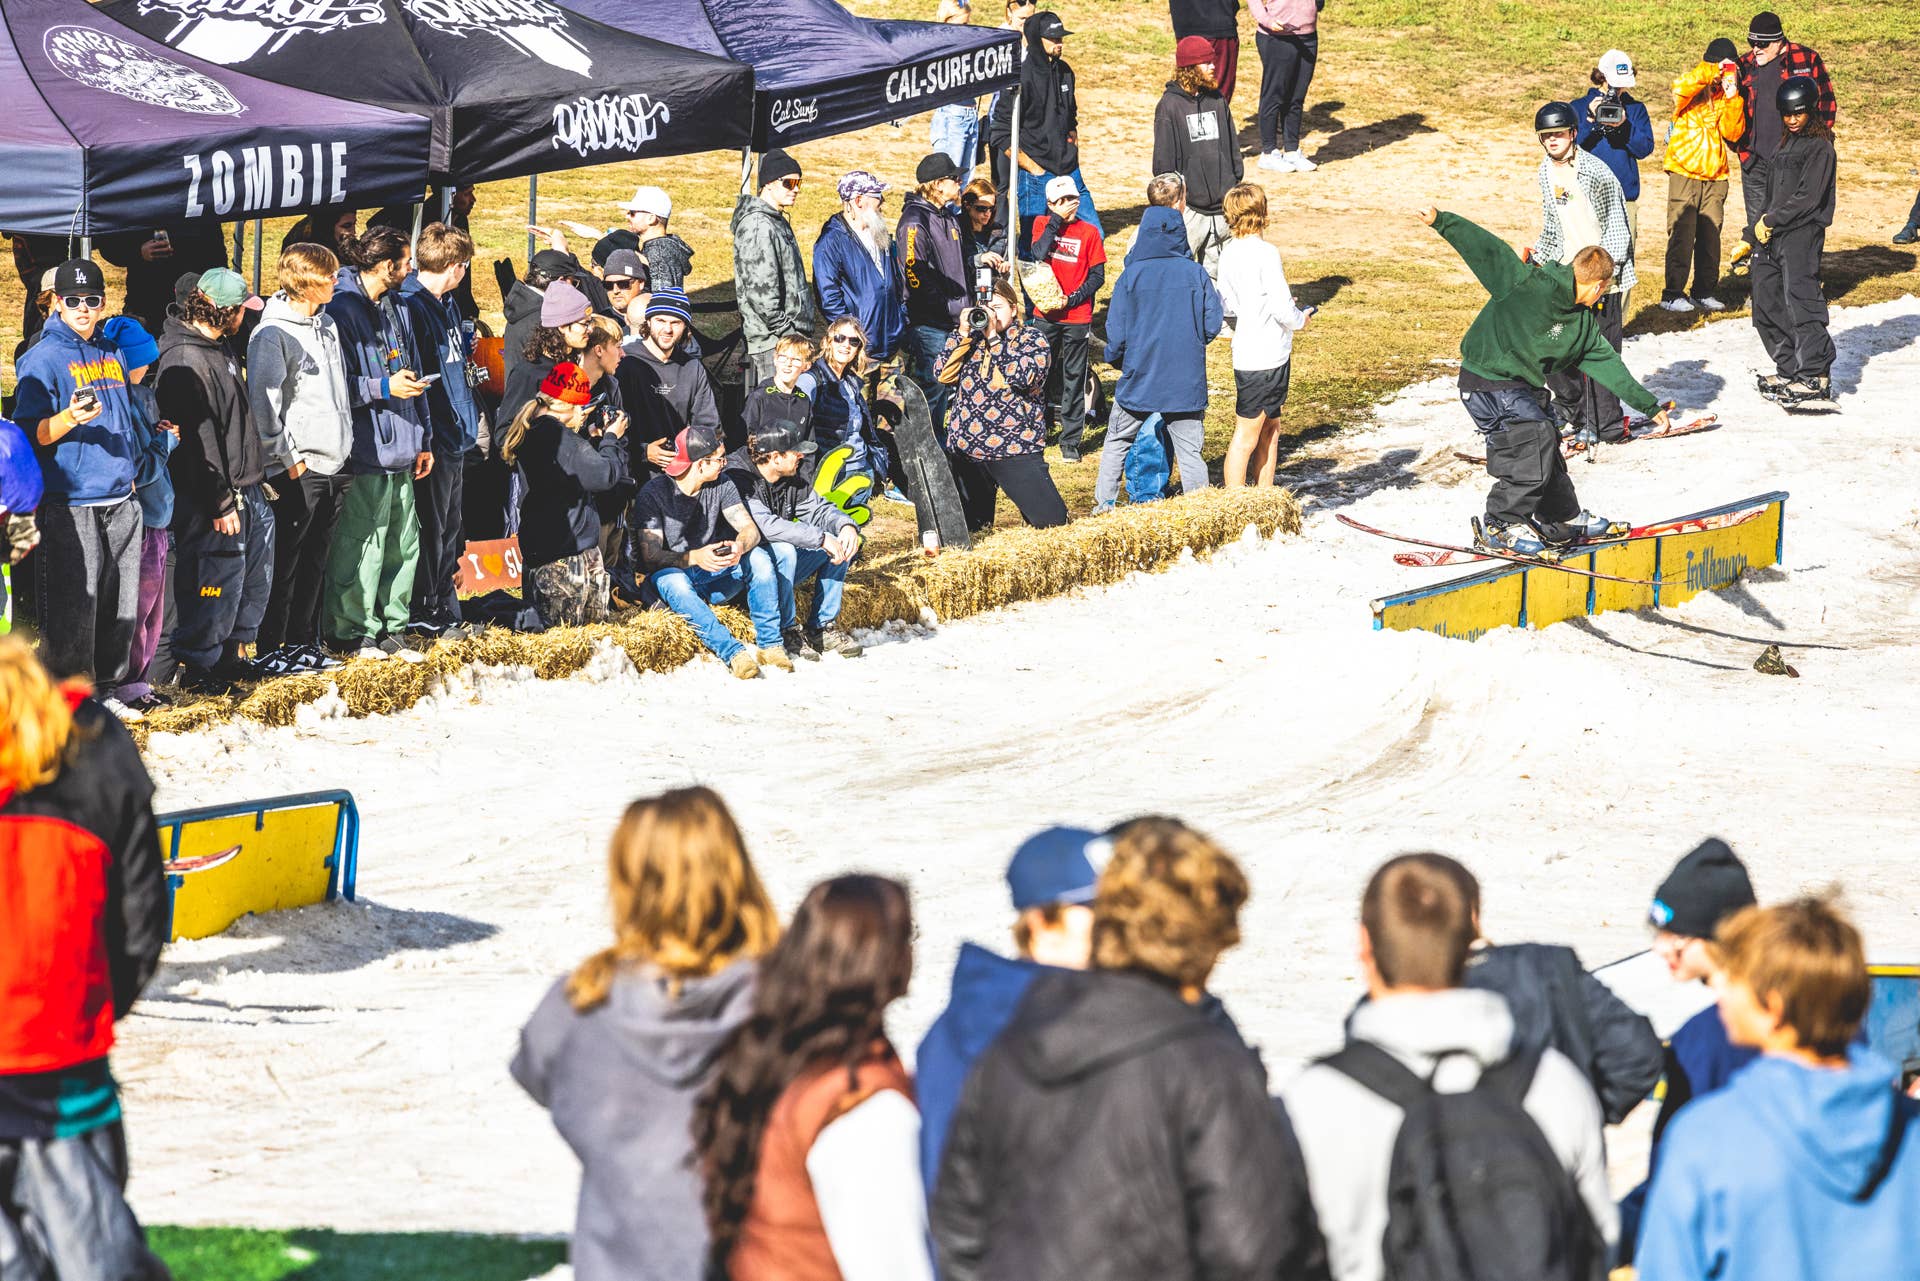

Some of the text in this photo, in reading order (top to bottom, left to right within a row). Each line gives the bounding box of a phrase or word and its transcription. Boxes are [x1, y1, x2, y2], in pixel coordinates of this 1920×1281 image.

[52, 30, 140, 67] ZOMBIE
[885, 43, 1013, 104] CAL-SURF.COM
[552, 93, 670, 157] DAMAGE
[770, 98, 819, 127] Cal Surf
[183, 141, 348, 218] ZOMBIE
[74, 268, 88, 284] LA
[199, 586, 222, 598] HH
